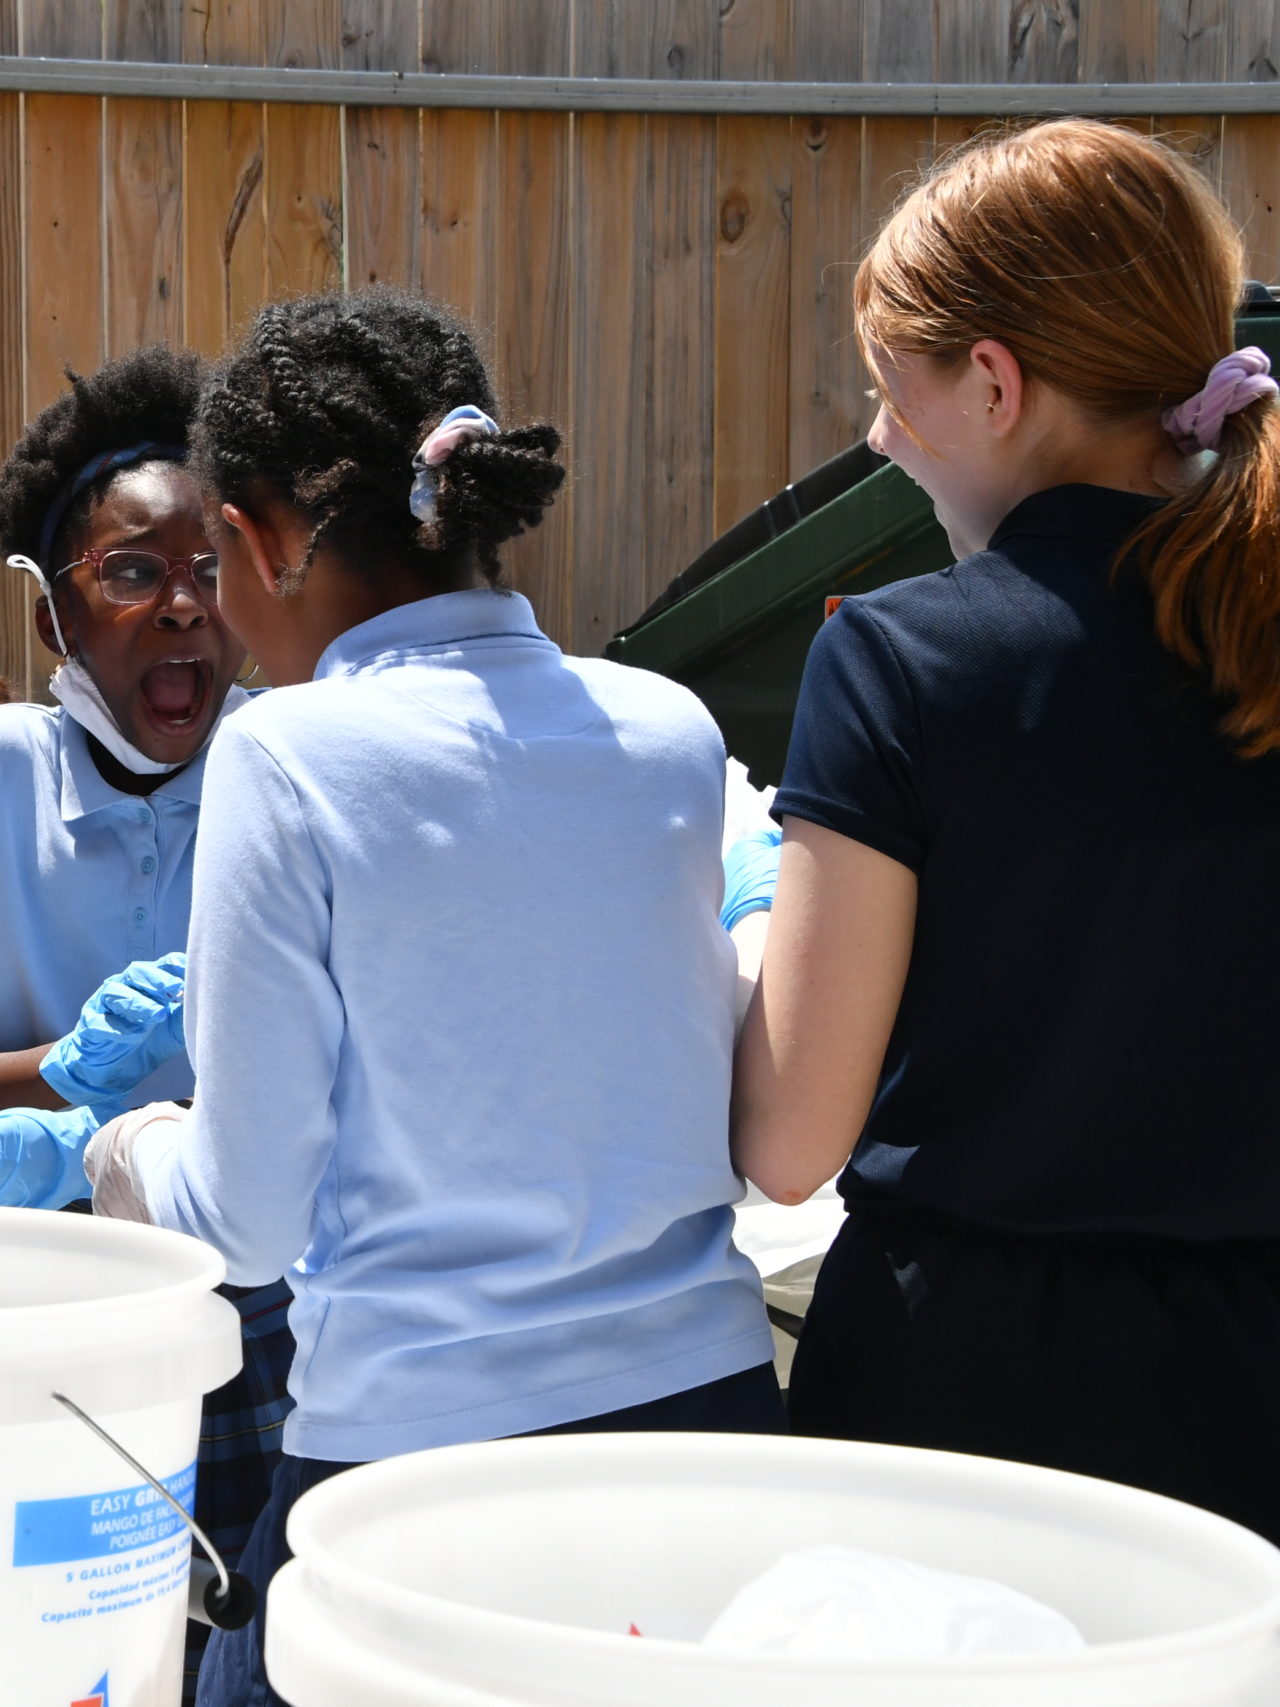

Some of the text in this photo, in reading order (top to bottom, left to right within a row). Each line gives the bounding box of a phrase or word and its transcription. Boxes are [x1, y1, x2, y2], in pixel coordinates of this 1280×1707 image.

[90, 1493, 131, 1516] EASY
[91, 1514, 138, 1536] MANGO
[140, 1508, 155, 1526] DE
[110, 1526, 157, 1550] POIGNÉE
[66, 1572, 74, 1583] 5
[80, 1562, 131, 1581] GALLON
[89, 1581, 140, 1601] Capacidad
[41, 1606, 93, 1624] Capacité
[96, 1597, 142, 1614] maximum
